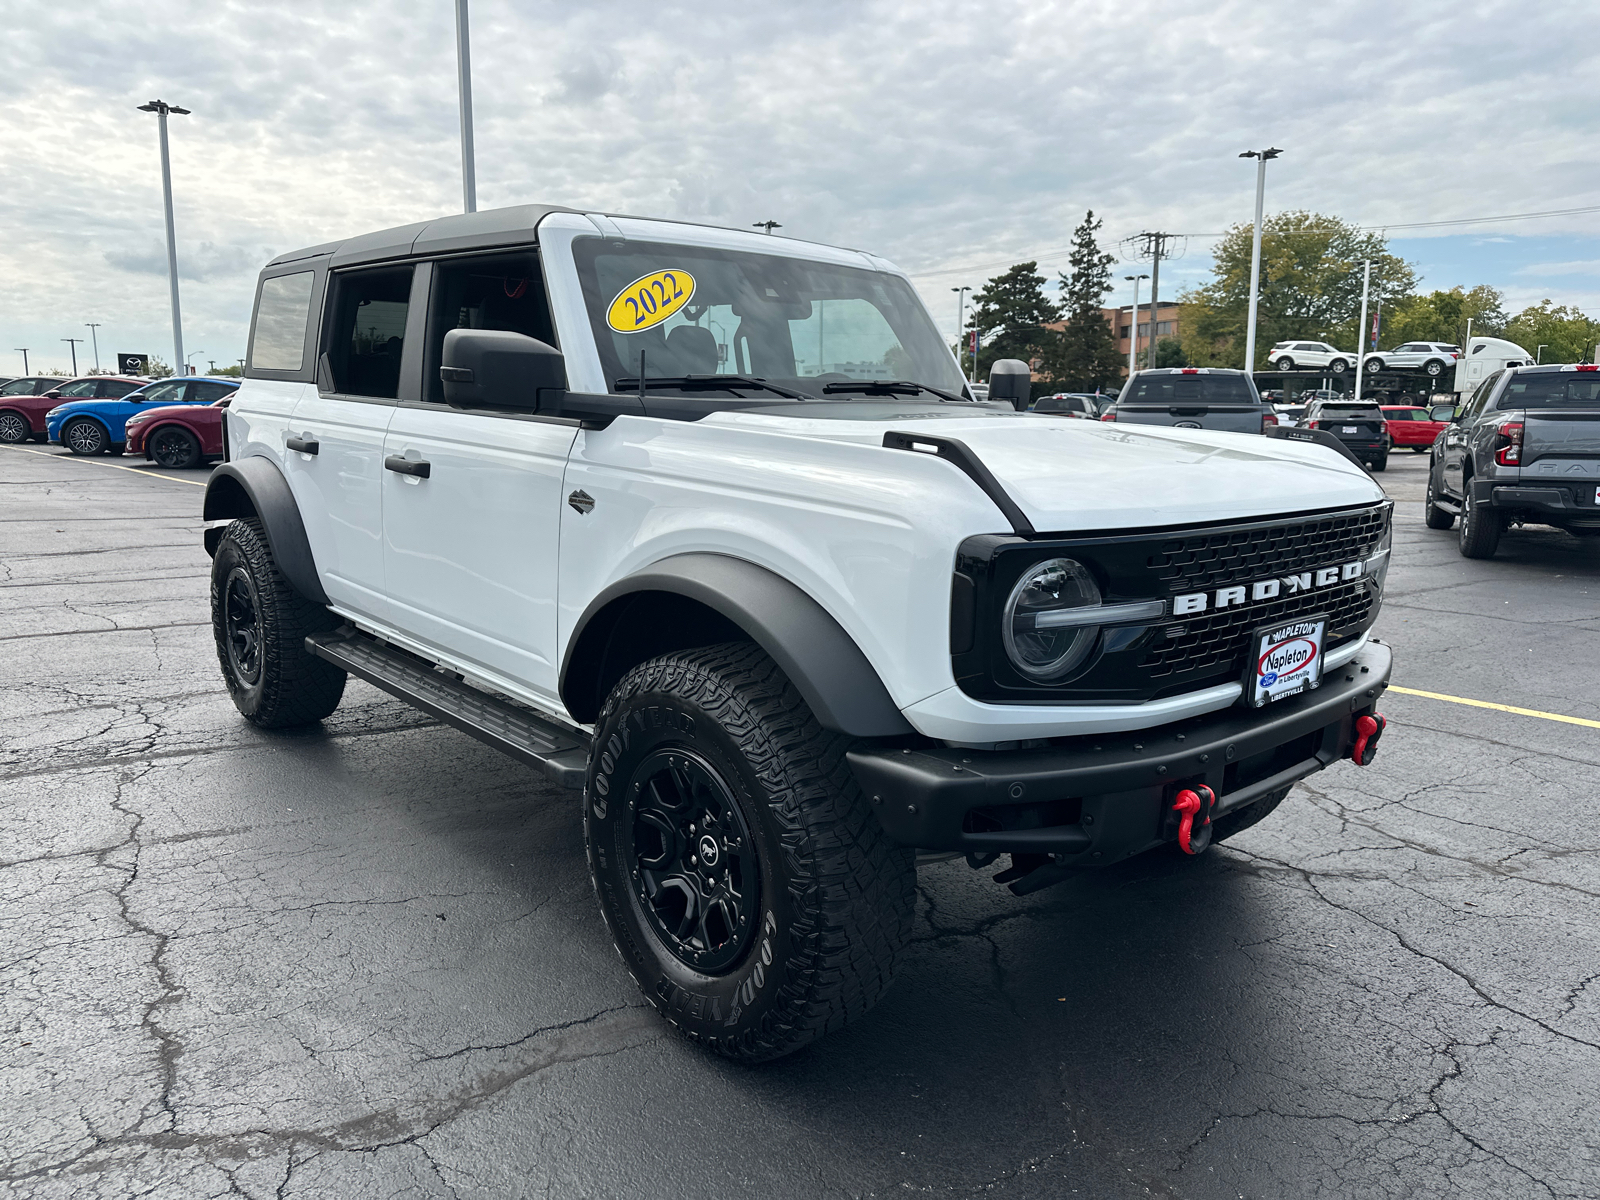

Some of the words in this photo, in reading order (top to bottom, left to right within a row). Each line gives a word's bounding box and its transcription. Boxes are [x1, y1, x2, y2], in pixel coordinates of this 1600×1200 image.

[625, 273, 683, 326] 2022
[1539, 464, 1600, 474] RA
[1173, 561, 1364, 616] BRONCO
[1266, 649, 1307, 672] Napleton
[1284, 670, 1310, 683] Libertyville
[1271, 686, 1304, 702] LIBERTYVILLE
